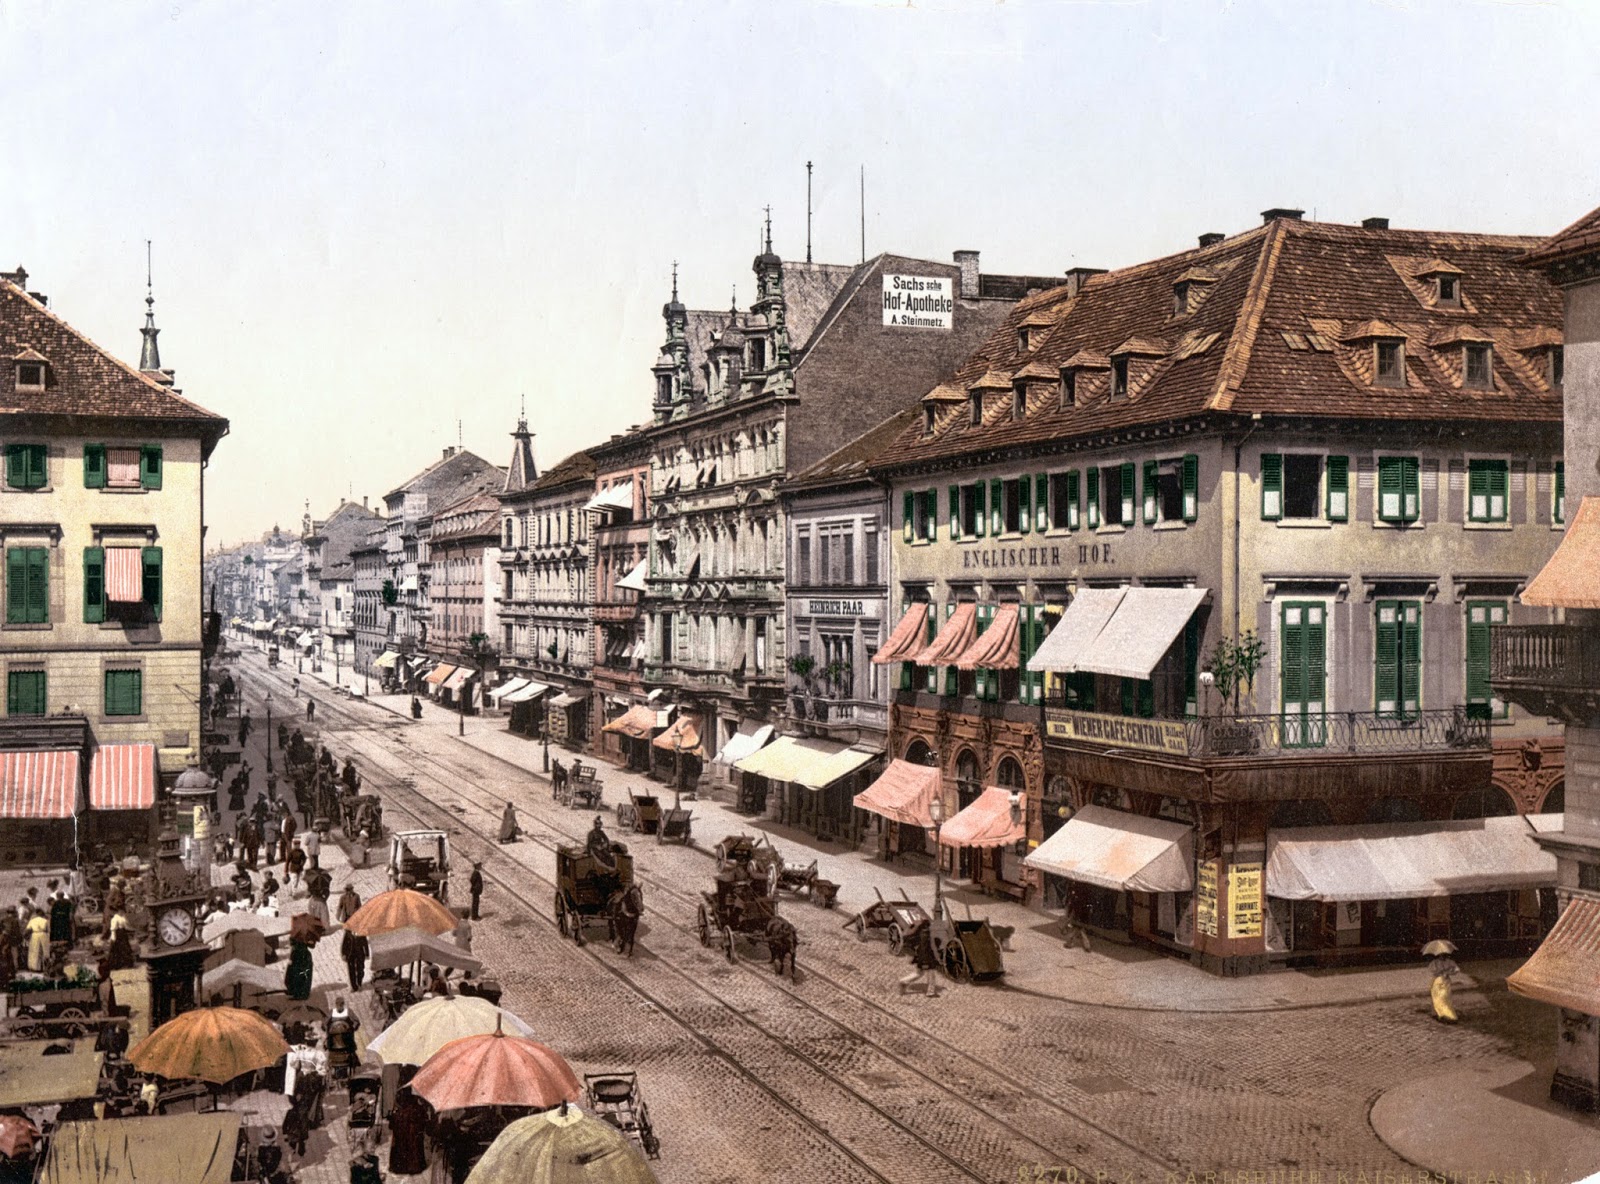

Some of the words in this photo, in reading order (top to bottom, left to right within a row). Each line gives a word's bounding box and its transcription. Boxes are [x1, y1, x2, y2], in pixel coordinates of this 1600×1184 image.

[893, 276, 925, 291] Sachs
[884, 291, 952, 314] Hof-Apotheke
[901, 315, 945, 327] Steinmetz.
[964, 547, 1060, 567] ENGLISCHER
[1079, 543, 1115, 563] HOF.
[809, 600, 841, 614] HEINRICH
[842, 601, 866, 615] PAAR.
[1073, 716, 1103, 739] WIENER
[1127, 722, 1166, 748] CENTRAL
